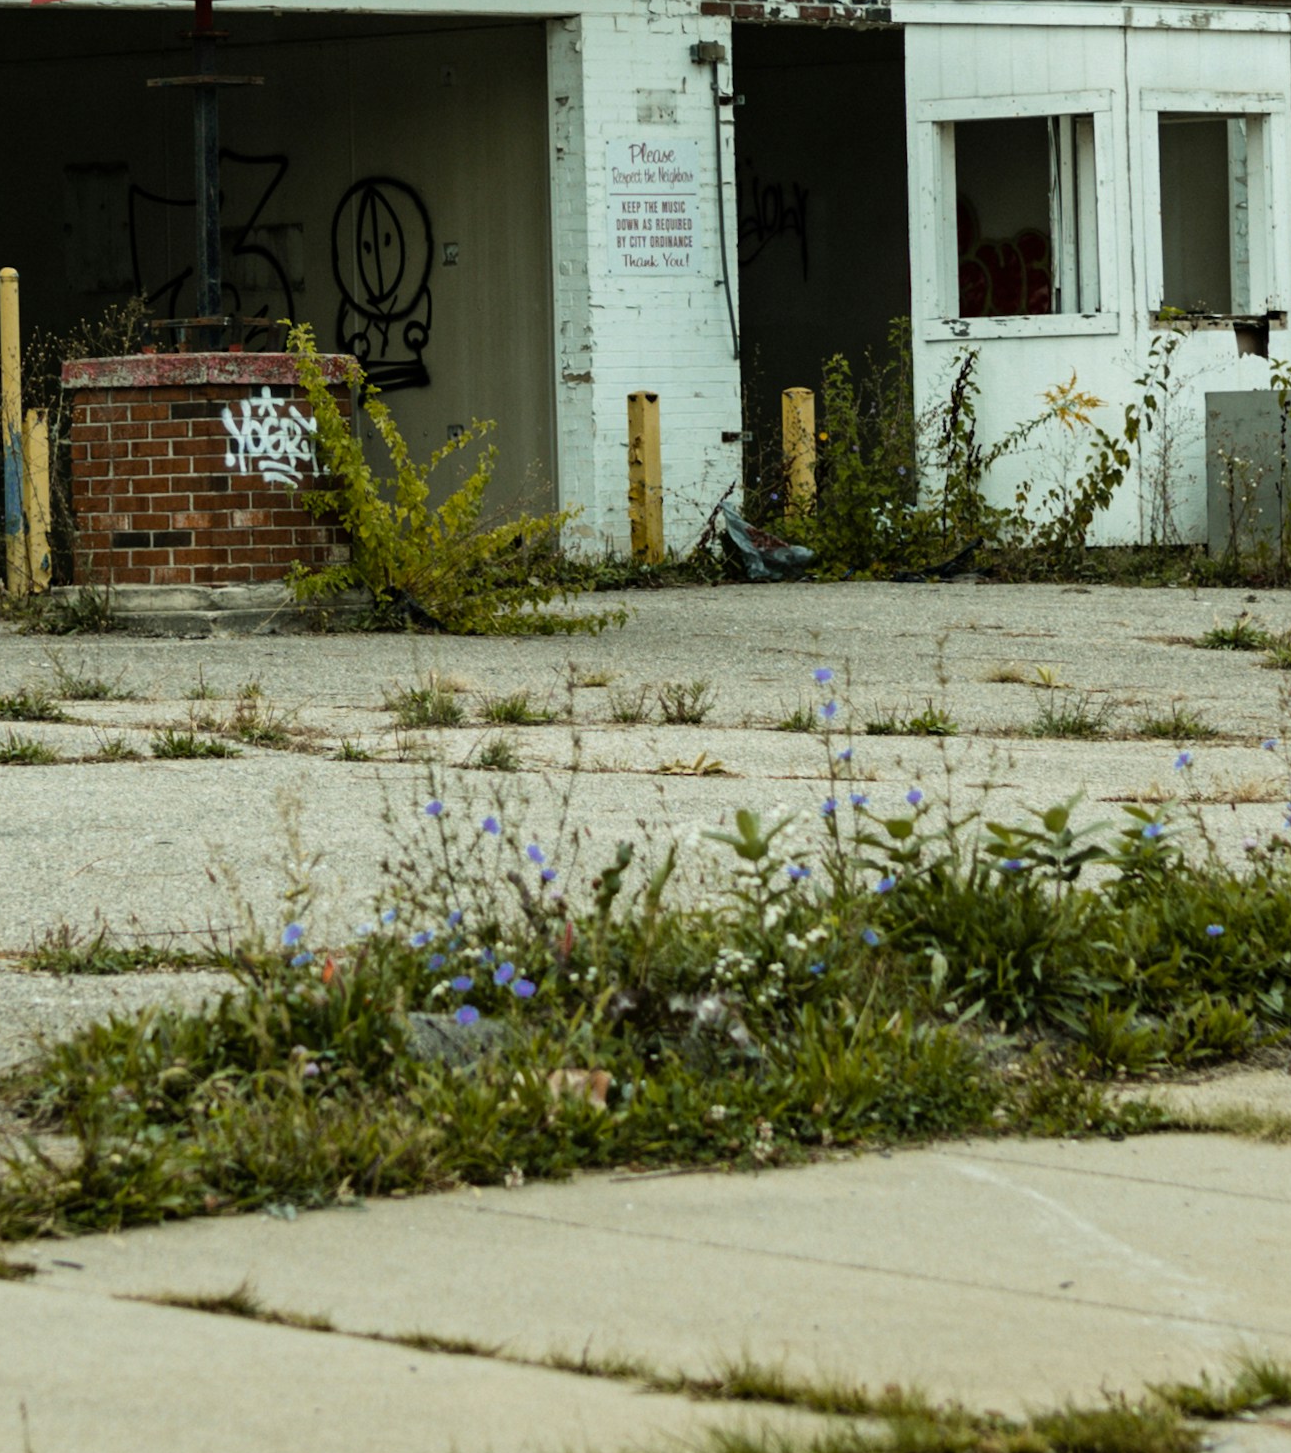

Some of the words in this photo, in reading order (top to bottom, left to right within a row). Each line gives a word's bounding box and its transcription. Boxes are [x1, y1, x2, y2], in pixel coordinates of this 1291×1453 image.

[628, 142, 676, 164] Please
[612, 167, 642, 188] Respect
[644, 169, 657, 184] the
[658, 167, 694, 190] Neighbors
[621, 201, 641, 213] KEEP
[644, 201, 658, 213] THE
[662, 201, 686, 213] MUSIC
[616, 218, 639, 231] DOWN
[642, 218, 652, 231] AS
[656, 218, 692, 233] REQUIRED
[617, 236, 626, 248] BY
[629, 236, 646, 248] CITY
[650, 236, 693, 248] ORDINANCE
[621, 253, 659, 268] Thank
[663, 252, 690, 268] You!
